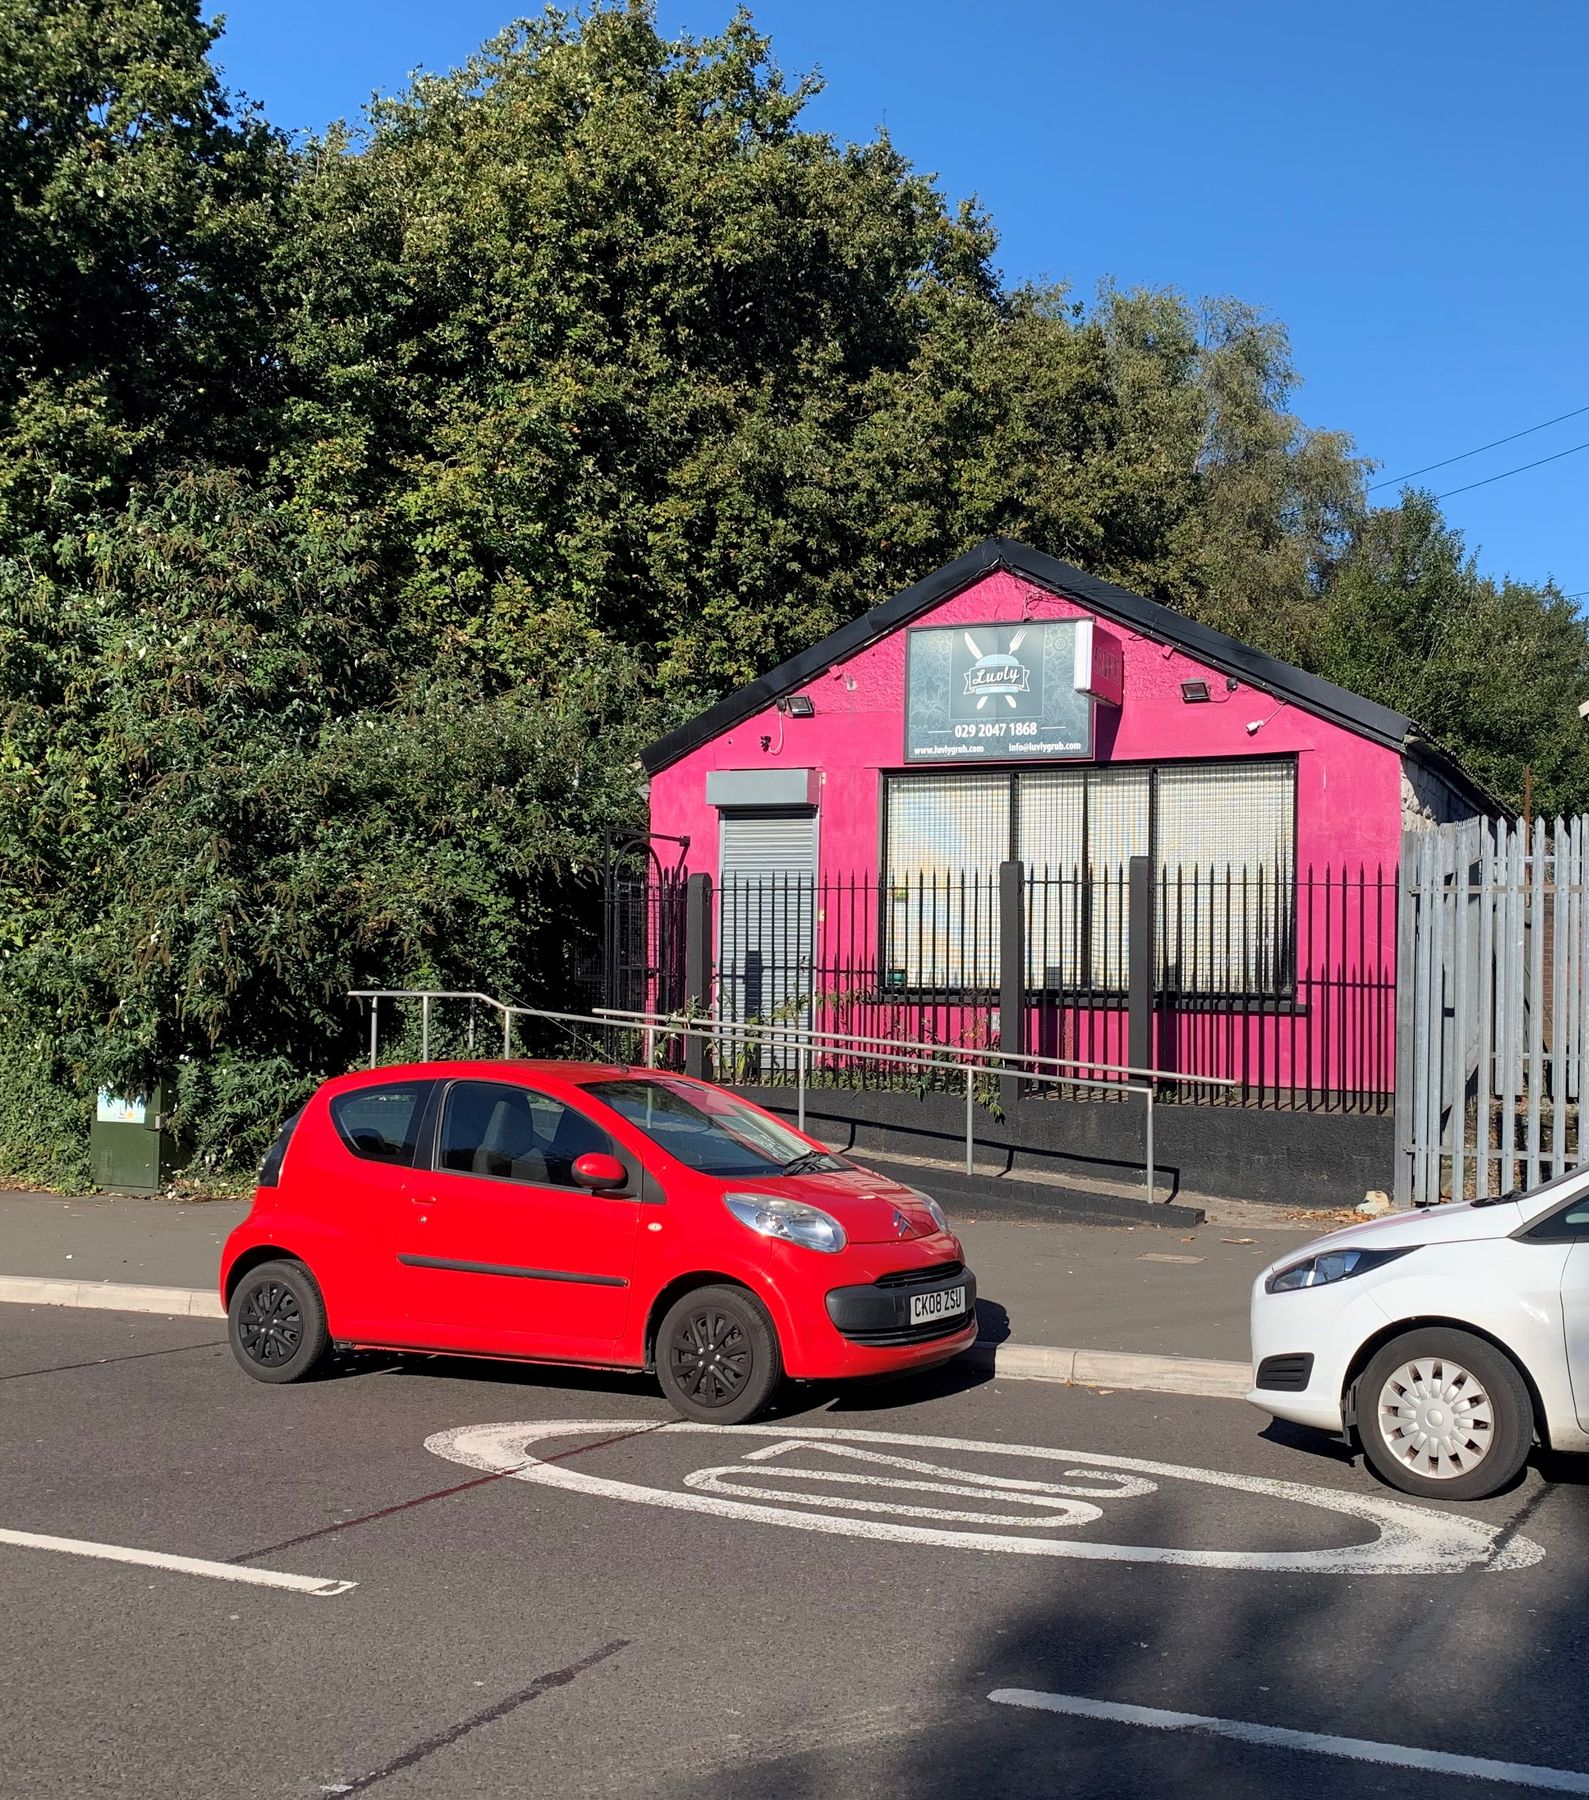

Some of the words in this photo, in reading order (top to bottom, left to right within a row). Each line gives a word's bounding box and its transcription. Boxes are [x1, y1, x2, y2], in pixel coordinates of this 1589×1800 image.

[972, 666, 1020, 684] Luvly
[955, 724, 976, 738] 029
[978, 723, 1006, 737] 2047
[1008, 722, 1037, 736] 1868
[914, 744, 984, 755] www.luvlygrub.com
[1008, 741, 1081, 753] info@luvlygrub.com
[914, 1293, 942, 1317] CK08
[944, 1288, 962, 1311] ZSU
[682, 1438, 1159, 1528] 20
